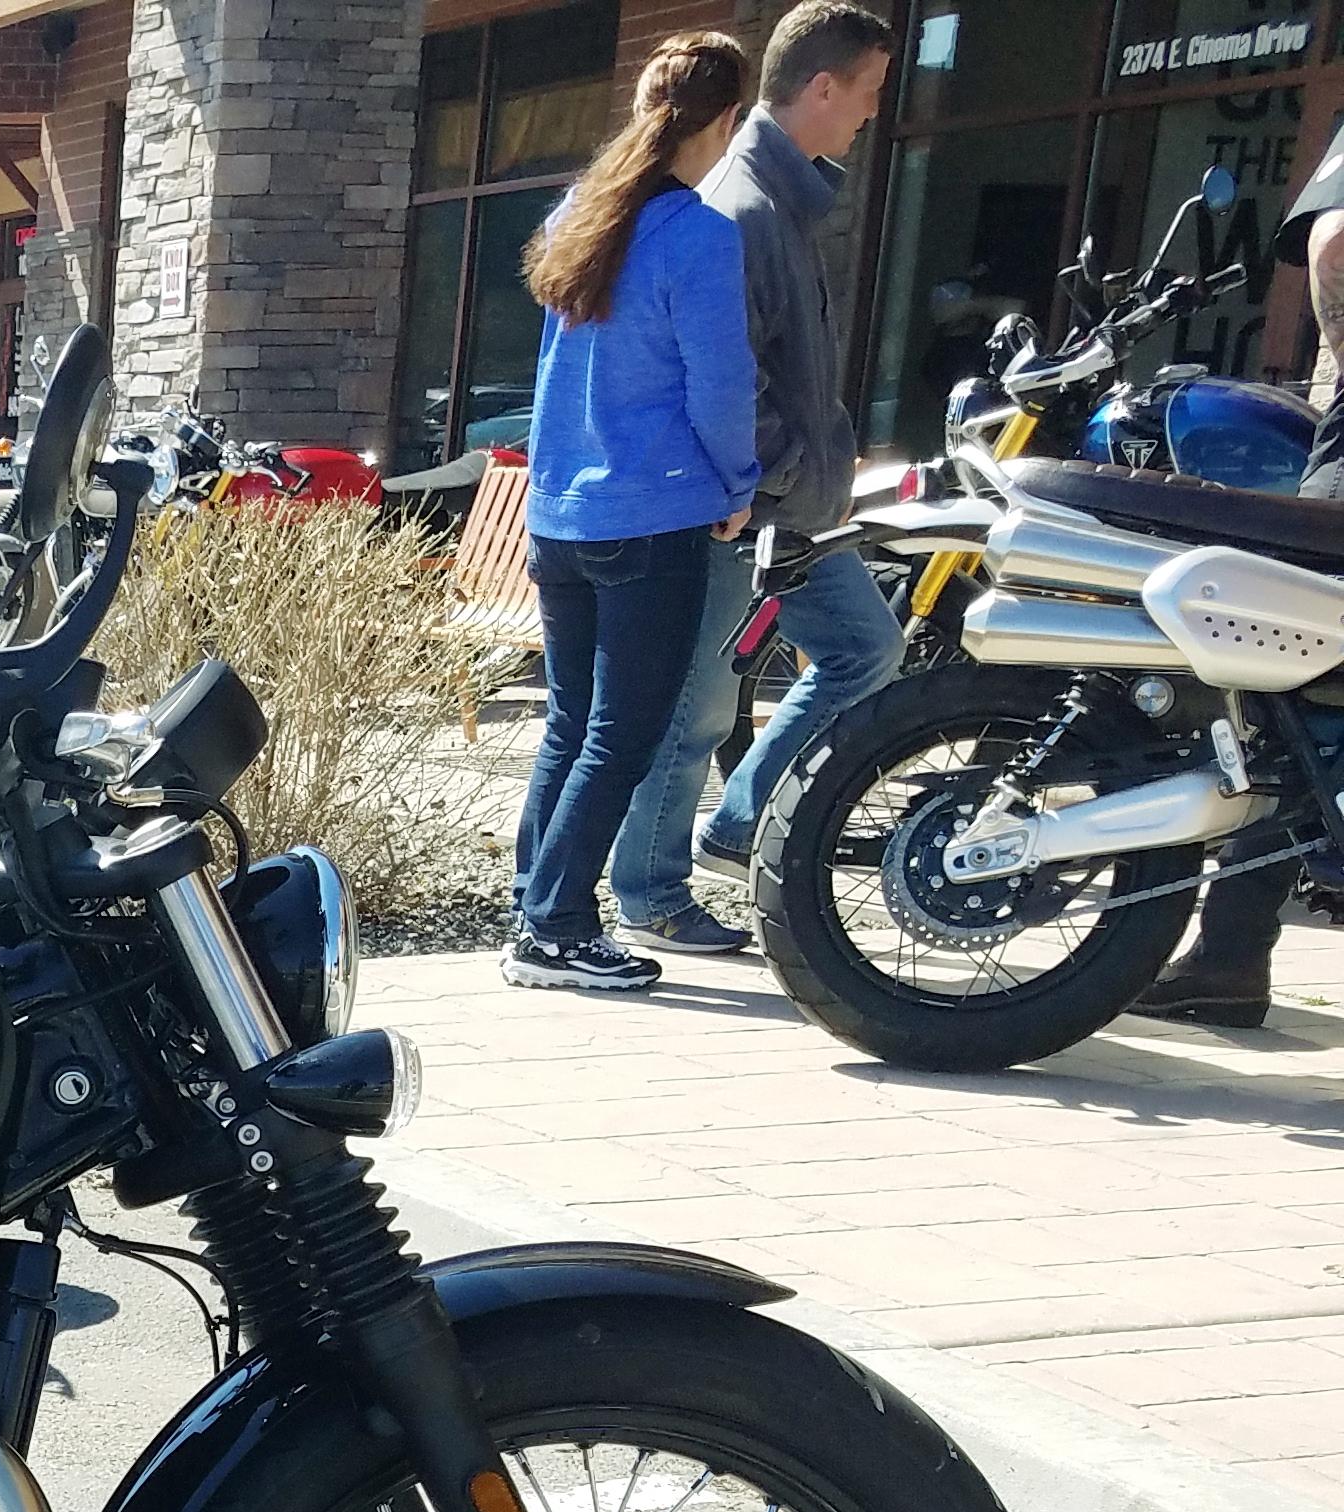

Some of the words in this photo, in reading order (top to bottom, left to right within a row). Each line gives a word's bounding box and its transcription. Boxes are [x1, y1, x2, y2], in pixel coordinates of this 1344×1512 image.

[1119, 40, 1166, 76] 2374
[1167, 37, 1183, 70] E
[1186, 33, 1252, 67] Cinema
[1252, 20, 1310, 57] Drive
[164, 246, 184, 269] KNOX
[165, 271, 181, 292] BOX
